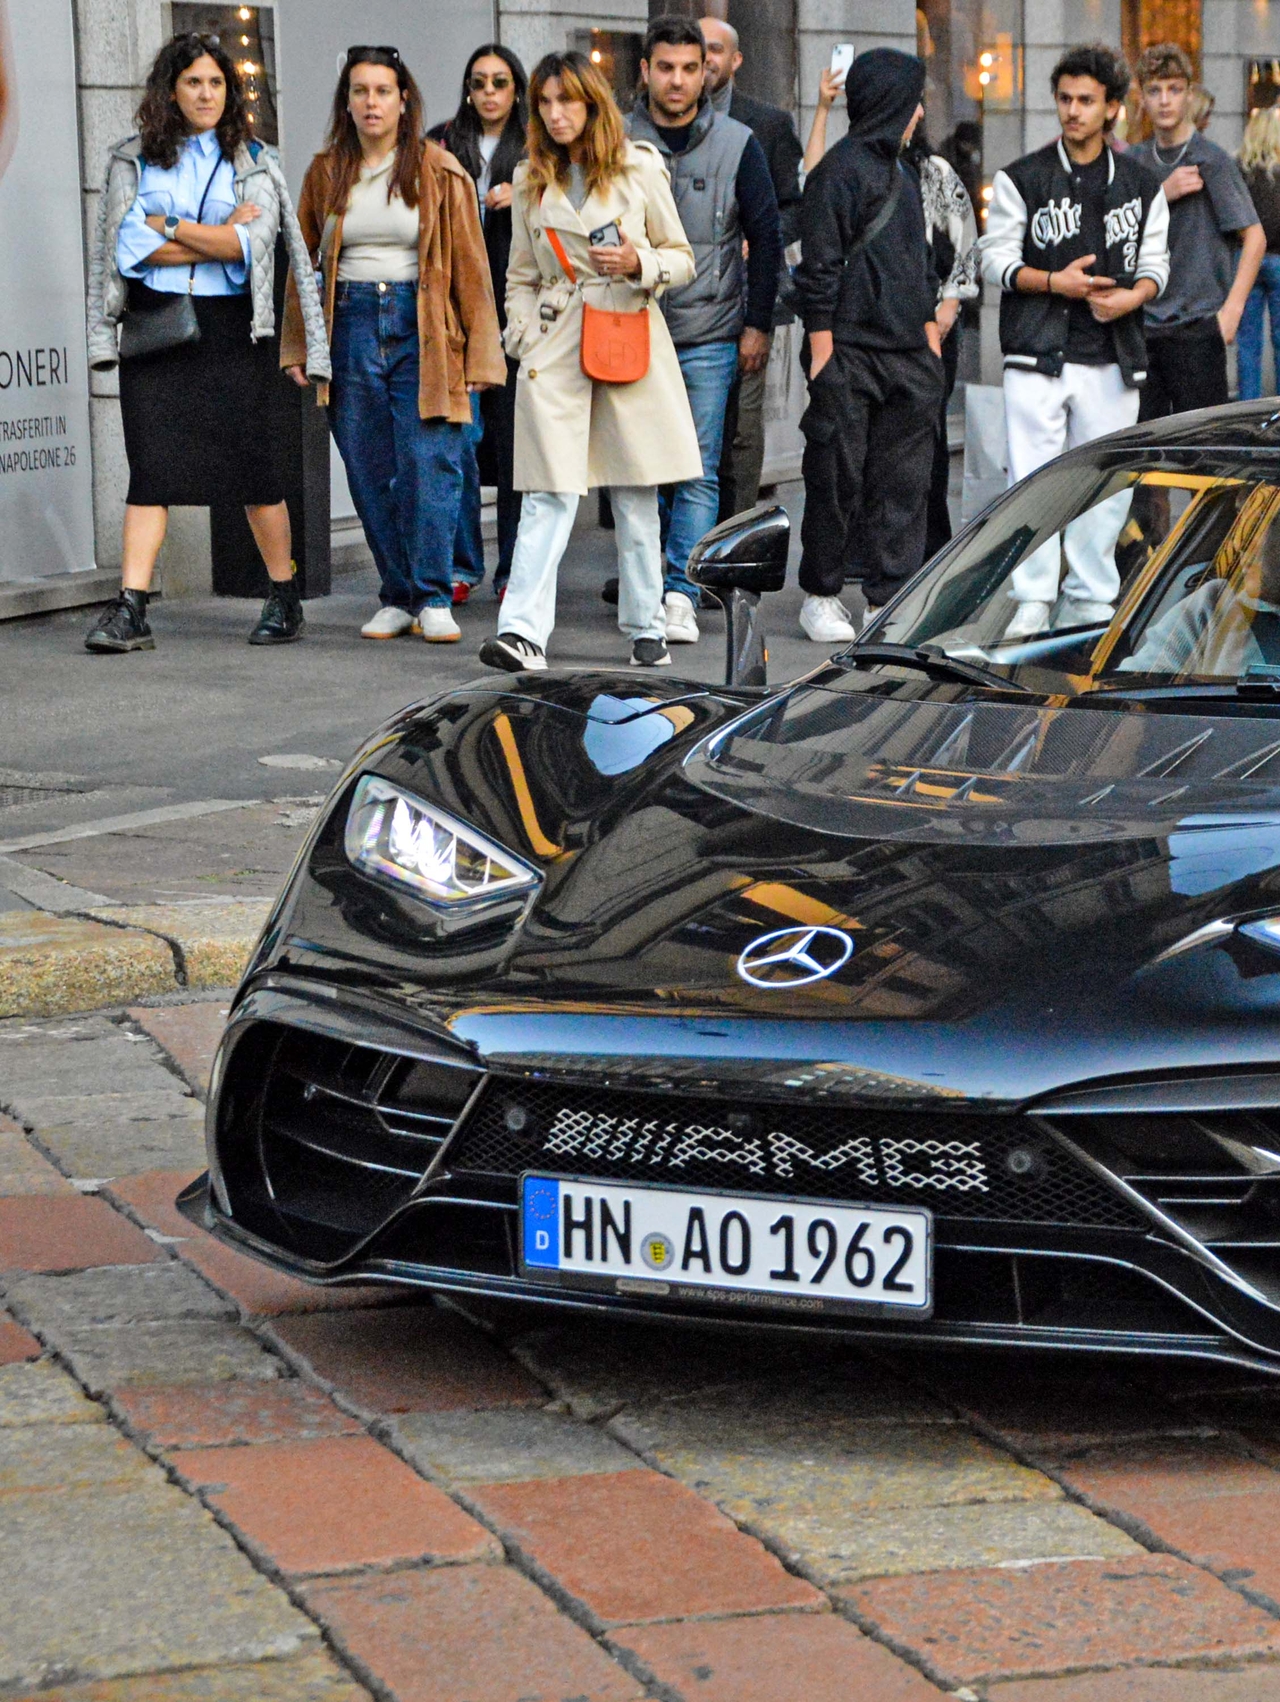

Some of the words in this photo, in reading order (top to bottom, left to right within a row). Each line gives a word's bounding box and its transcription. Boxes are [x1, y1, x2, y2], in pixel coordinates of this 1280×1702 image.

[55, 415, 67, 435] IN
[0, 447, 61, 474] NAPOLEONE
[64, 445, 76, 467] 26
[535, 1229, 549, 1250] D
[563, 1193, 632, 1265] HN
[681, 1206, 751, 1276] AO
[769, 1214, 915, 1293] 1962
